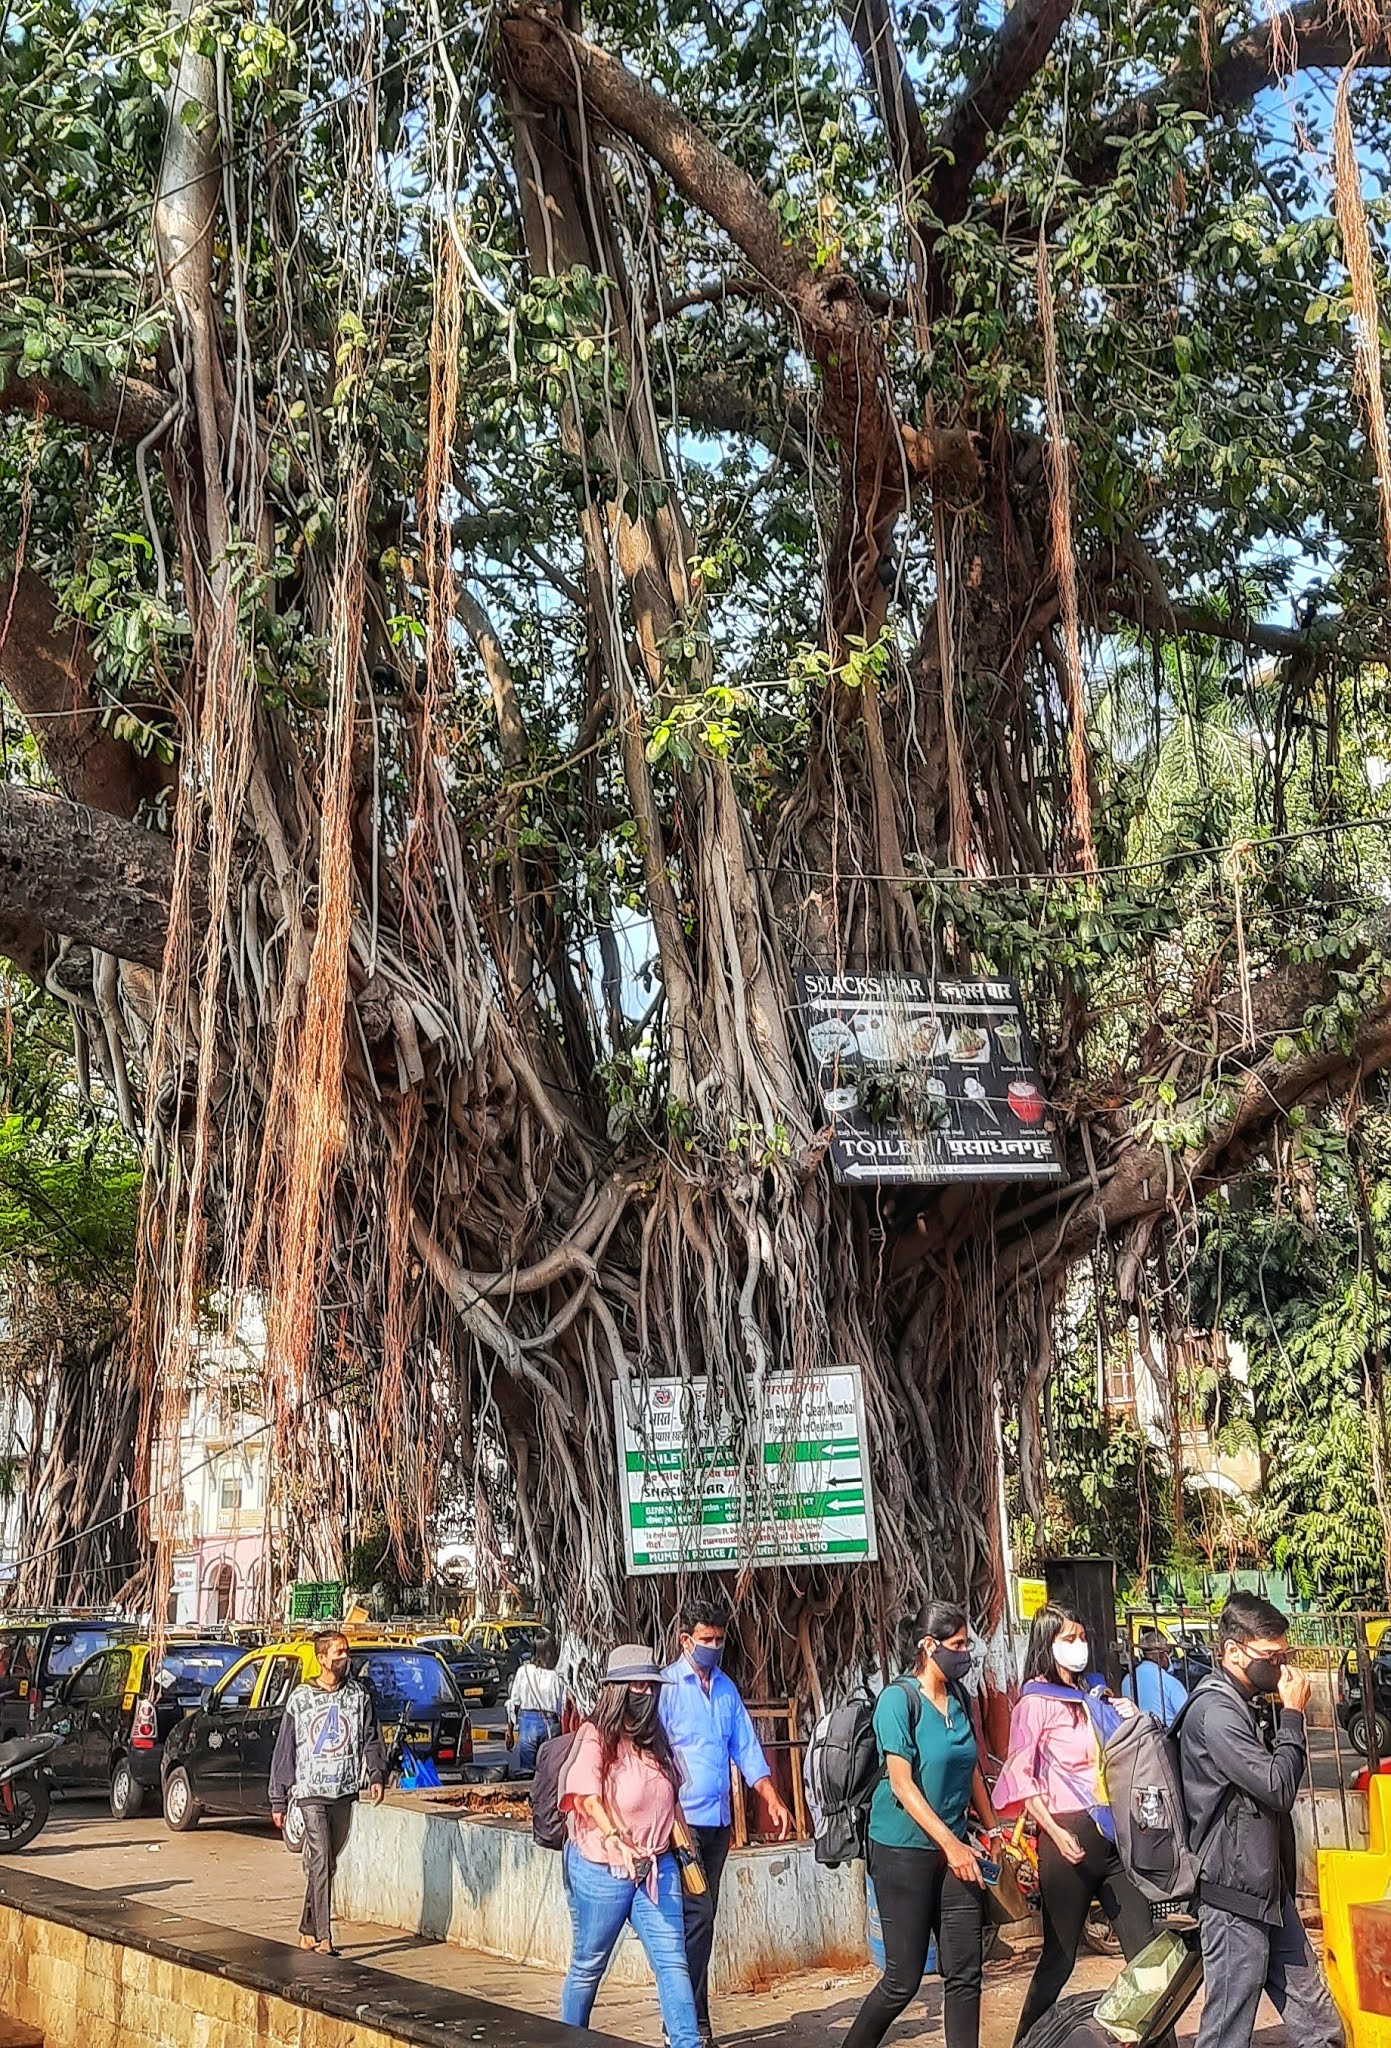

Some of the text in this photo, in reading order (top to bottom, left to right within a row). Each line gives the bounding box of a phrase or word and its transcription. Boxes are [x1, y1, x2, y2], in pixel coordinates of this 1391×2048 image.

[804, 975, 925, 996] SNACKS BAR
[985, 983, 1012, 999] बार
[839, 1139, 928, 1157] TOILET
[827, 1400, 856, 1416] Mumbai
[644, 1483, 690, 1498] SNAC
[648, 1550, 692, 1563] MUMBI
[693, 1547, 726, 1561] POLICE
